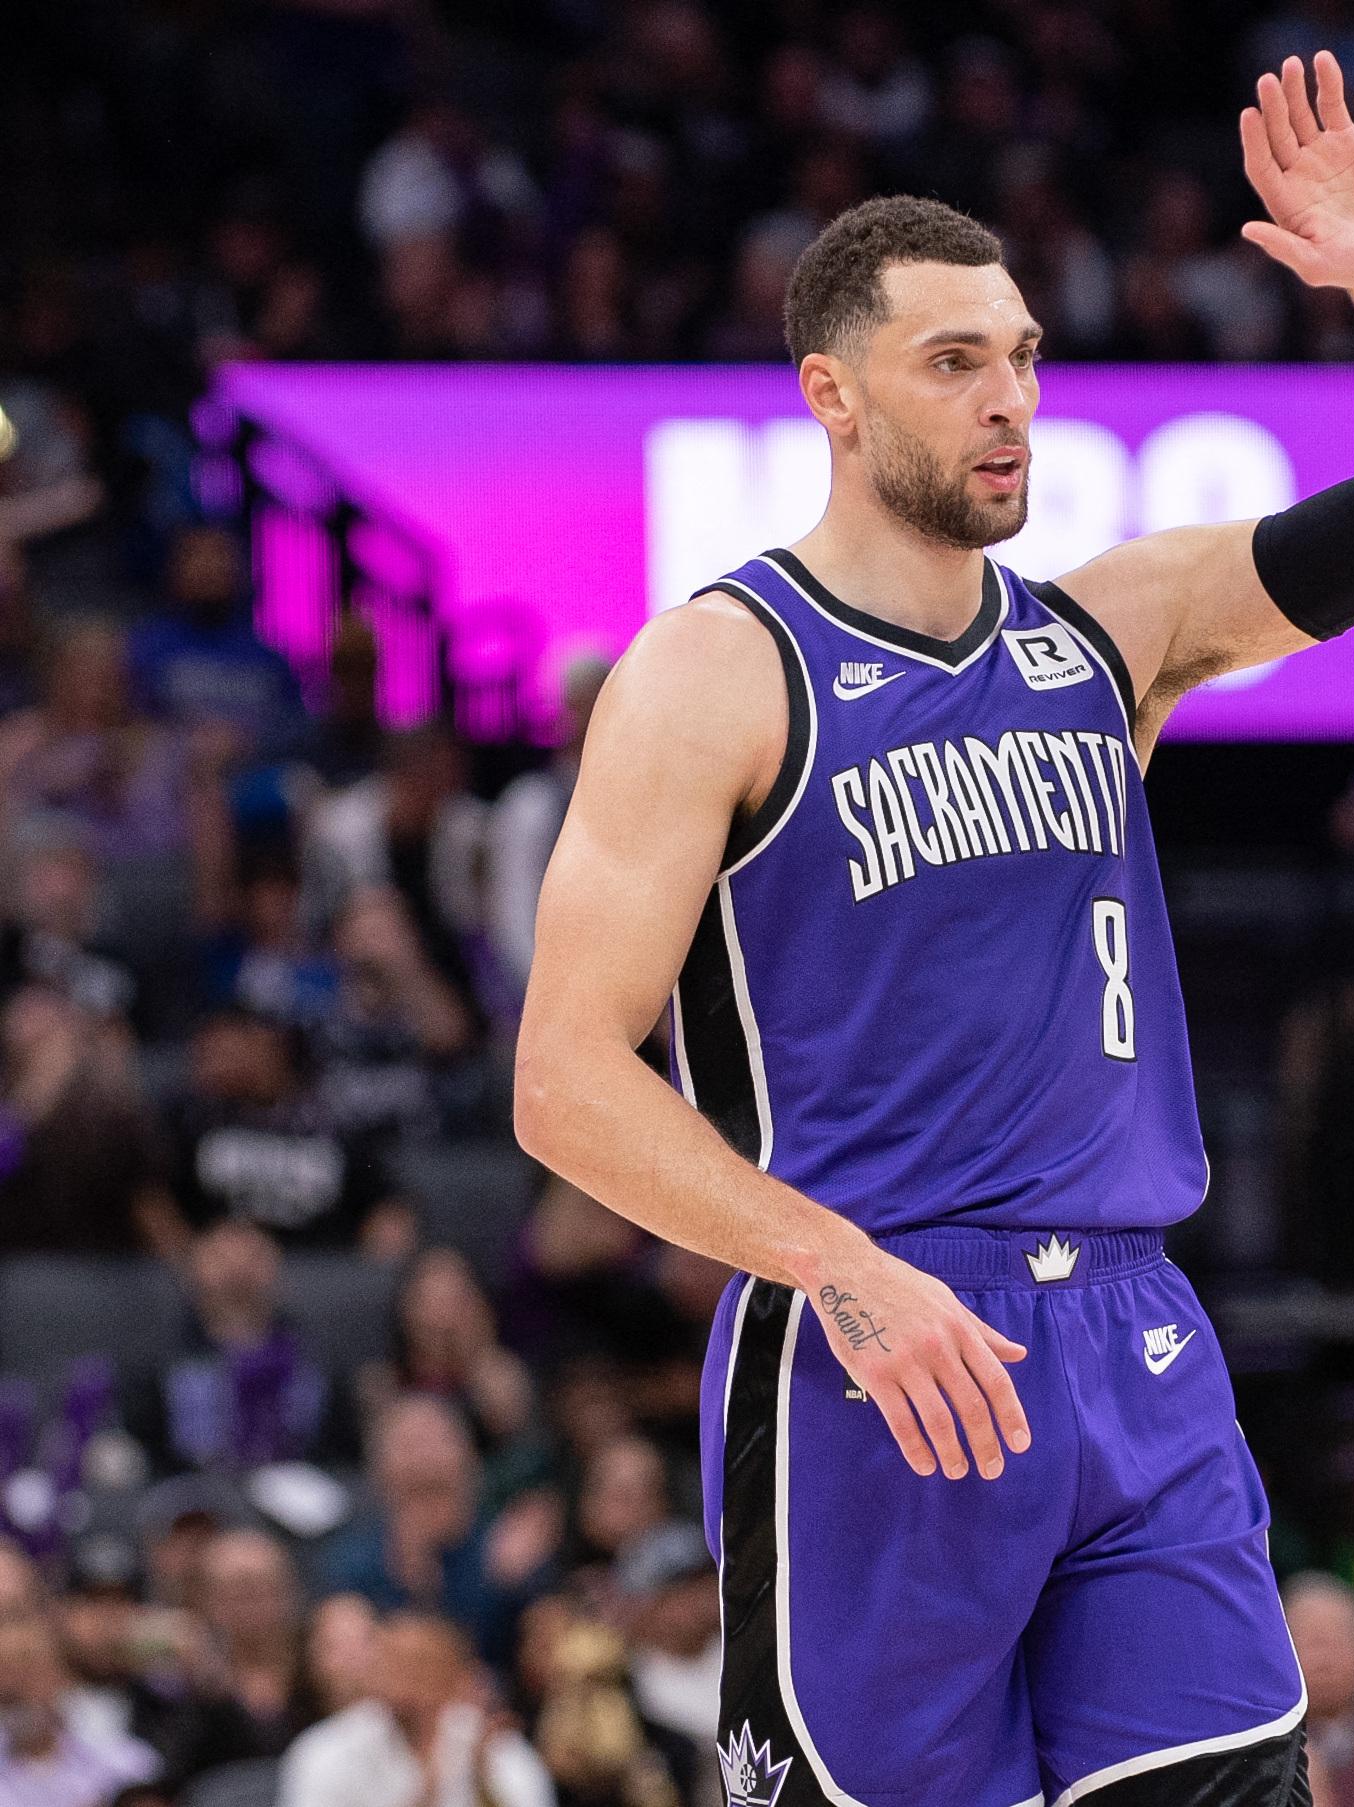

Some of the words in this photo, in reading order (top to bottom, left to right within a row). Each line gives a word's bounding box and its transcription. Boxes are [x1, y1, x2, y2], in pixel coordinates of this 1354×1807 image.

[1015, 636, 1068, 667] R
[839, 661, 884, 685] NIKE
[1028, 664, 1087, 684] REVIVER
[830, 730, 1127, 902] SACRAMENTO
[1091, 896, 1138, 1062] 8
[1142, 1323, 1179, 1356] NIKE
[845, 1388, 863, 1400] NBA
